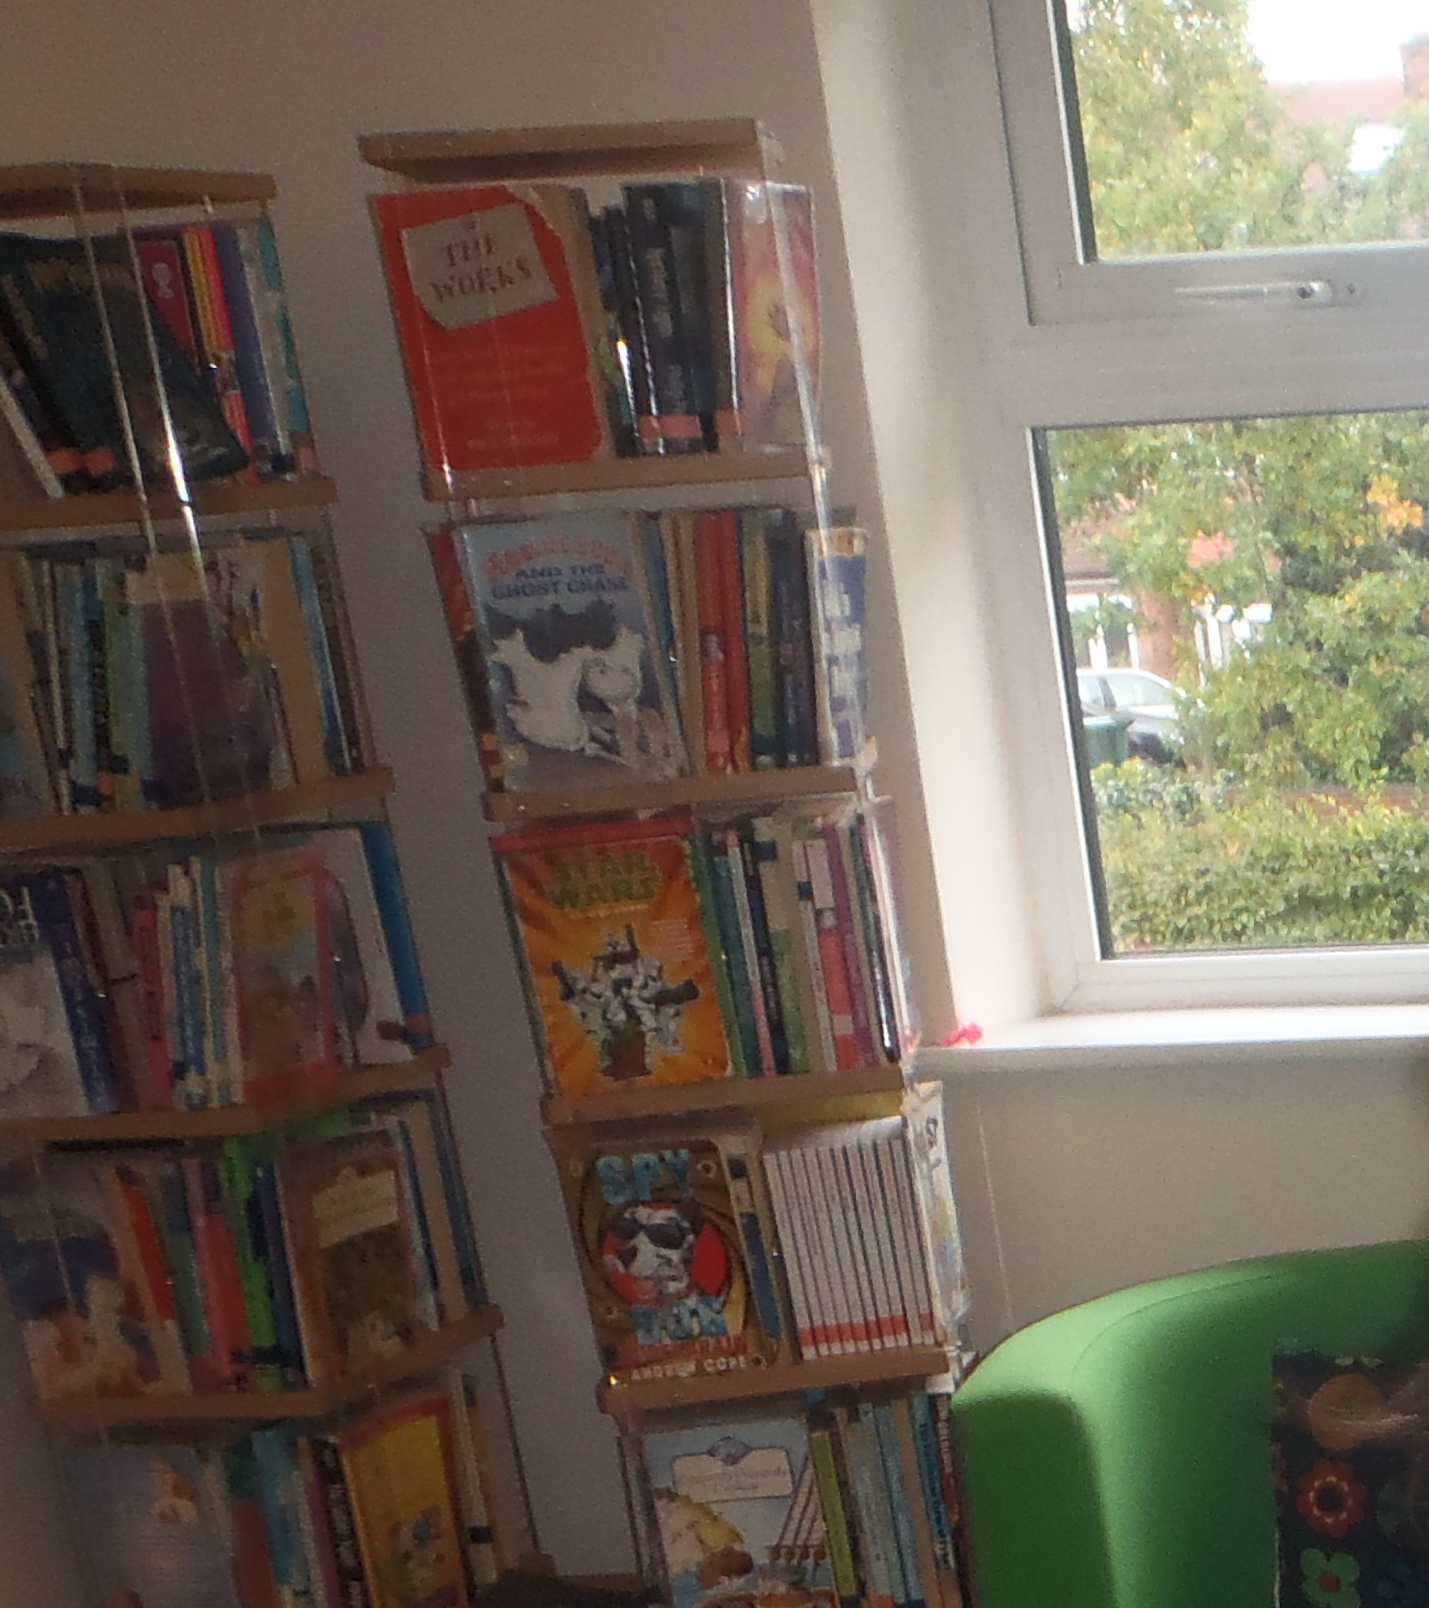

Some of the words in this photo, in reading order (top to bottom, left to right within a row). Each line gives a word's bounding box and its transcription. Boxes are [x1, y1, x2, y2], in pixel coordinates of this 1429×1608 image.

[430, 258, 531, 302] WORKS
[490, 580, 560, 600] GHOST
[596, 1148, 692, 1205] SPY
[702, 1354, 749, 1373] COPE
